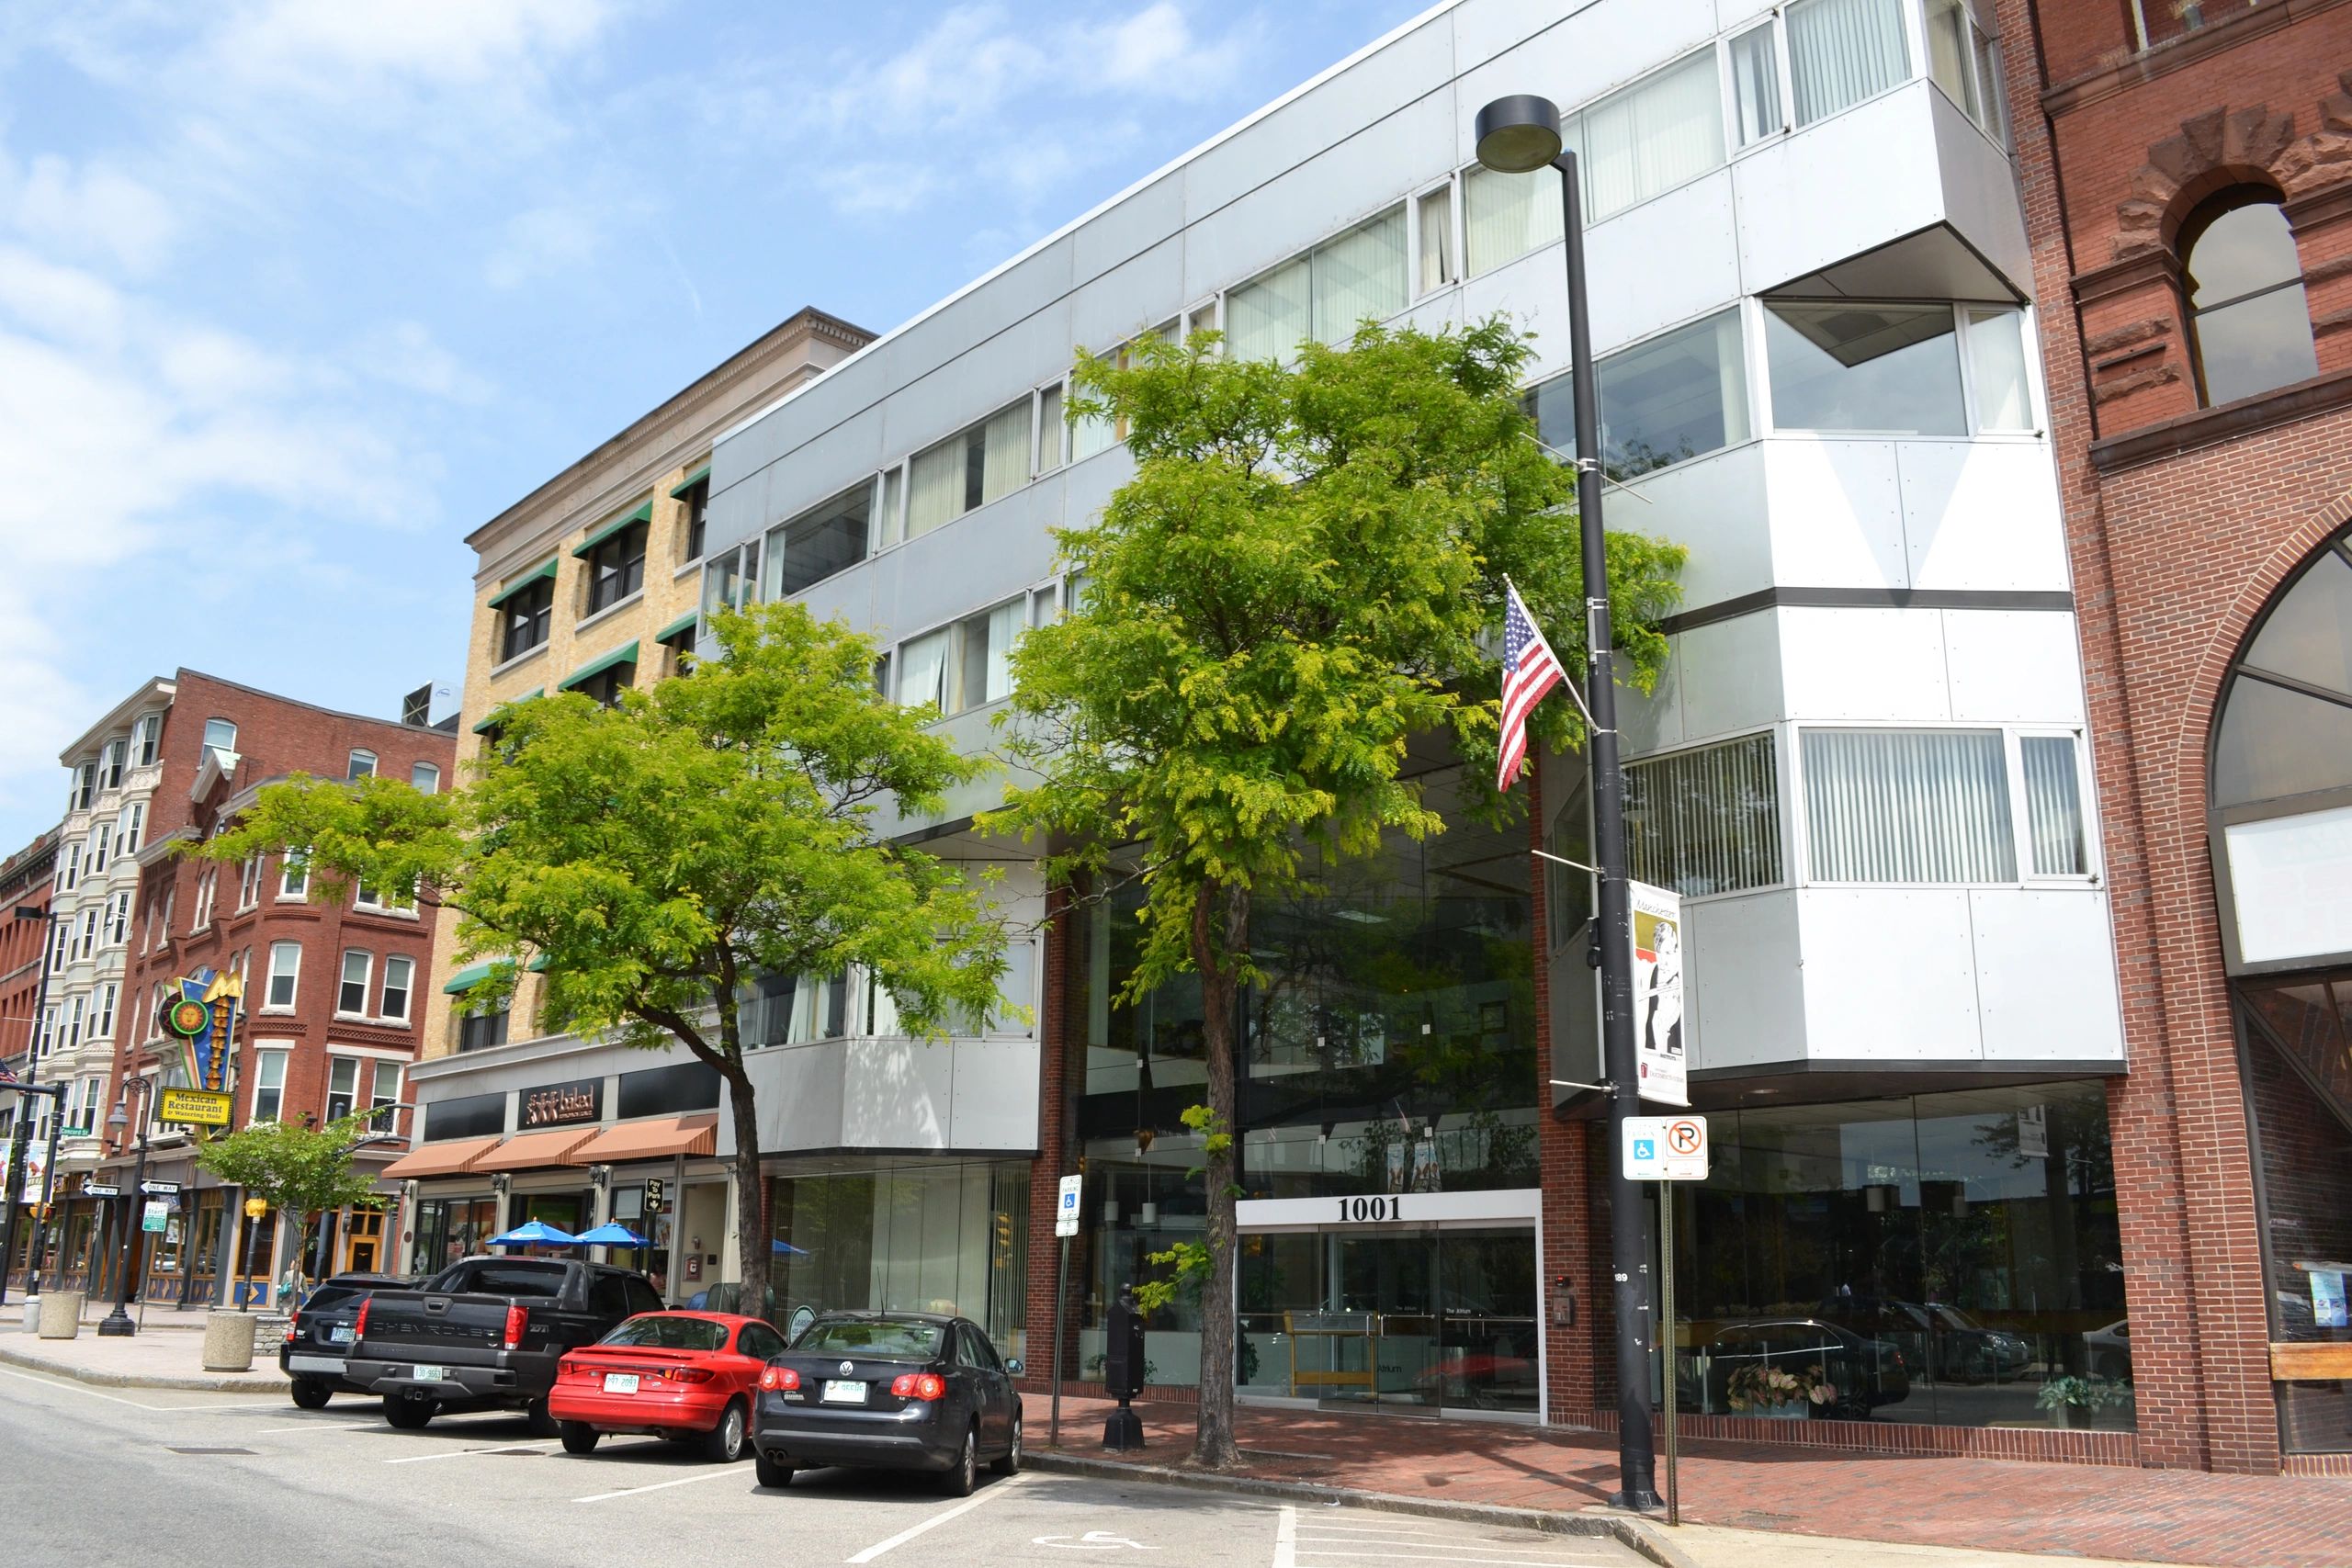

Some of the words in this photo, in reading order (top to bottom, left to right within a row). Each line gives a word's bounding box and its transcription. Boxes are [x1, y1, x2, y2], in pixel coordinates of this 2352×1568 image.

[175, 1093, 217, 1104] Mexican
[168, 1100, 222, 1112] Restaurant
[175, 1111, 205, 1119] Watering
[1338, 1196, 1402, 1221] 1001
